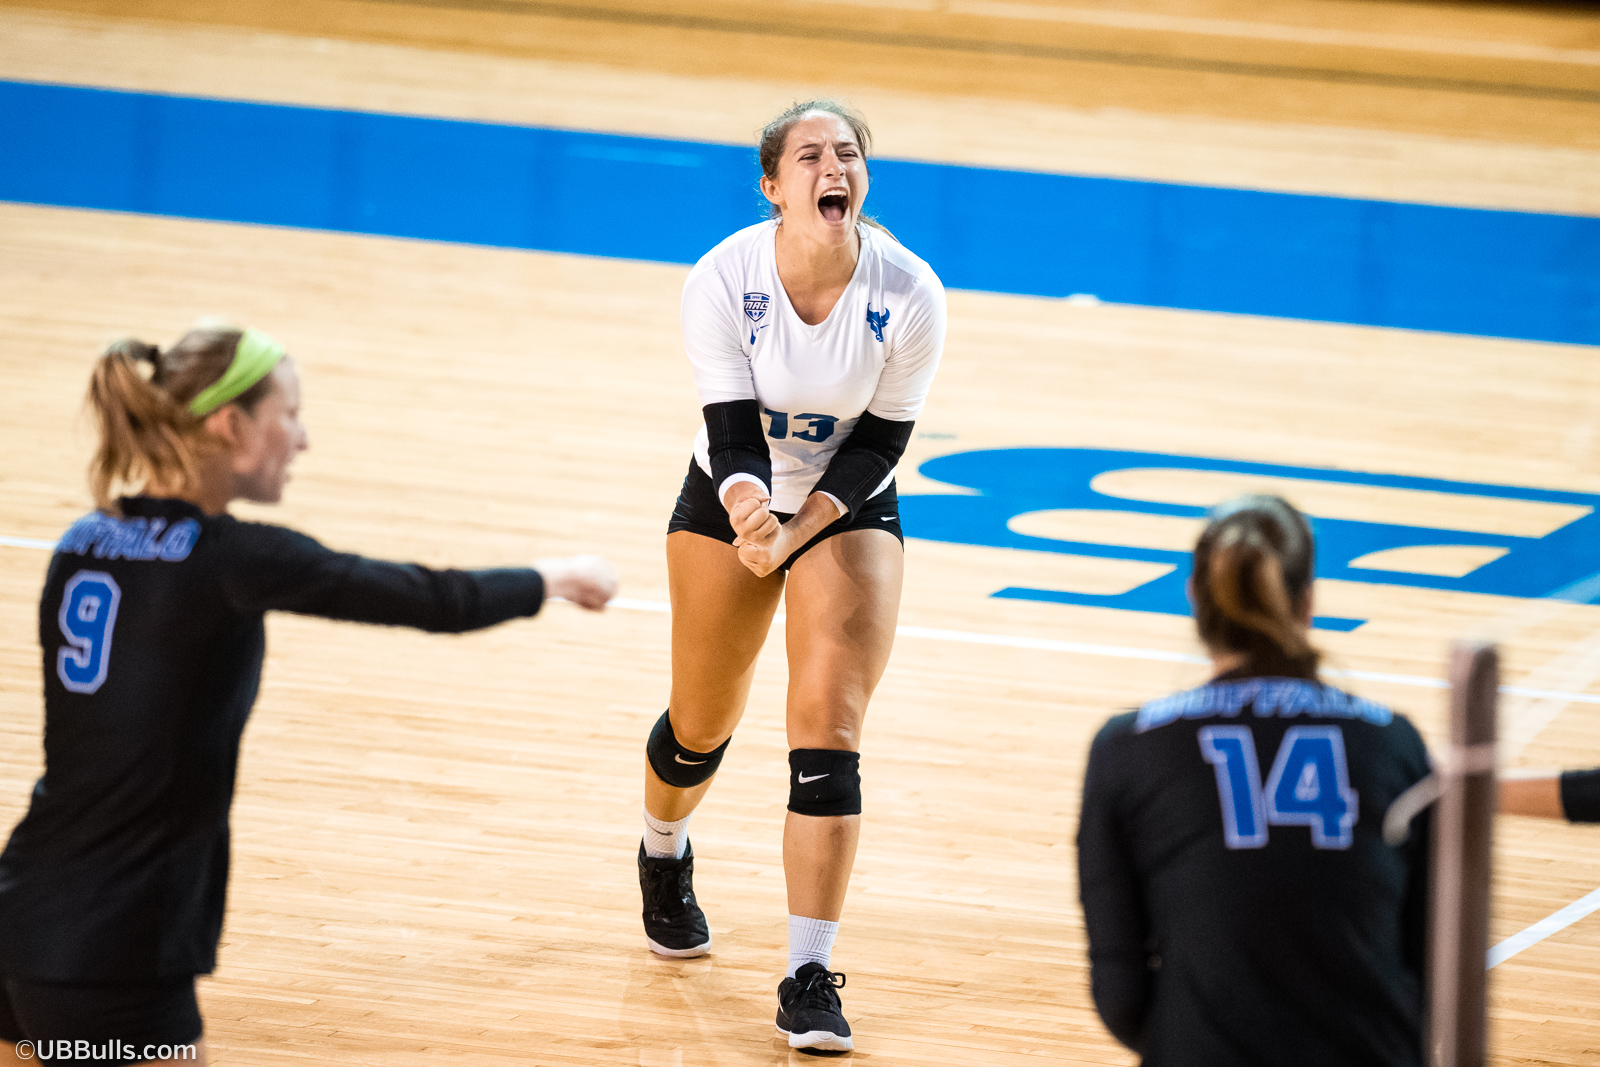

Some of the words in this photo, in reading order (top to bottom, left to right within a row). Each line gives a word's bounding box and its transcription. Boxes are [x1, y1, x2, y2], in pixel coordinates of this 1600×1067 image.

[764, 407, 840, 443] 13
[57, 569, 122, 694] 9
[1197, 725, 1359, 849] 14
